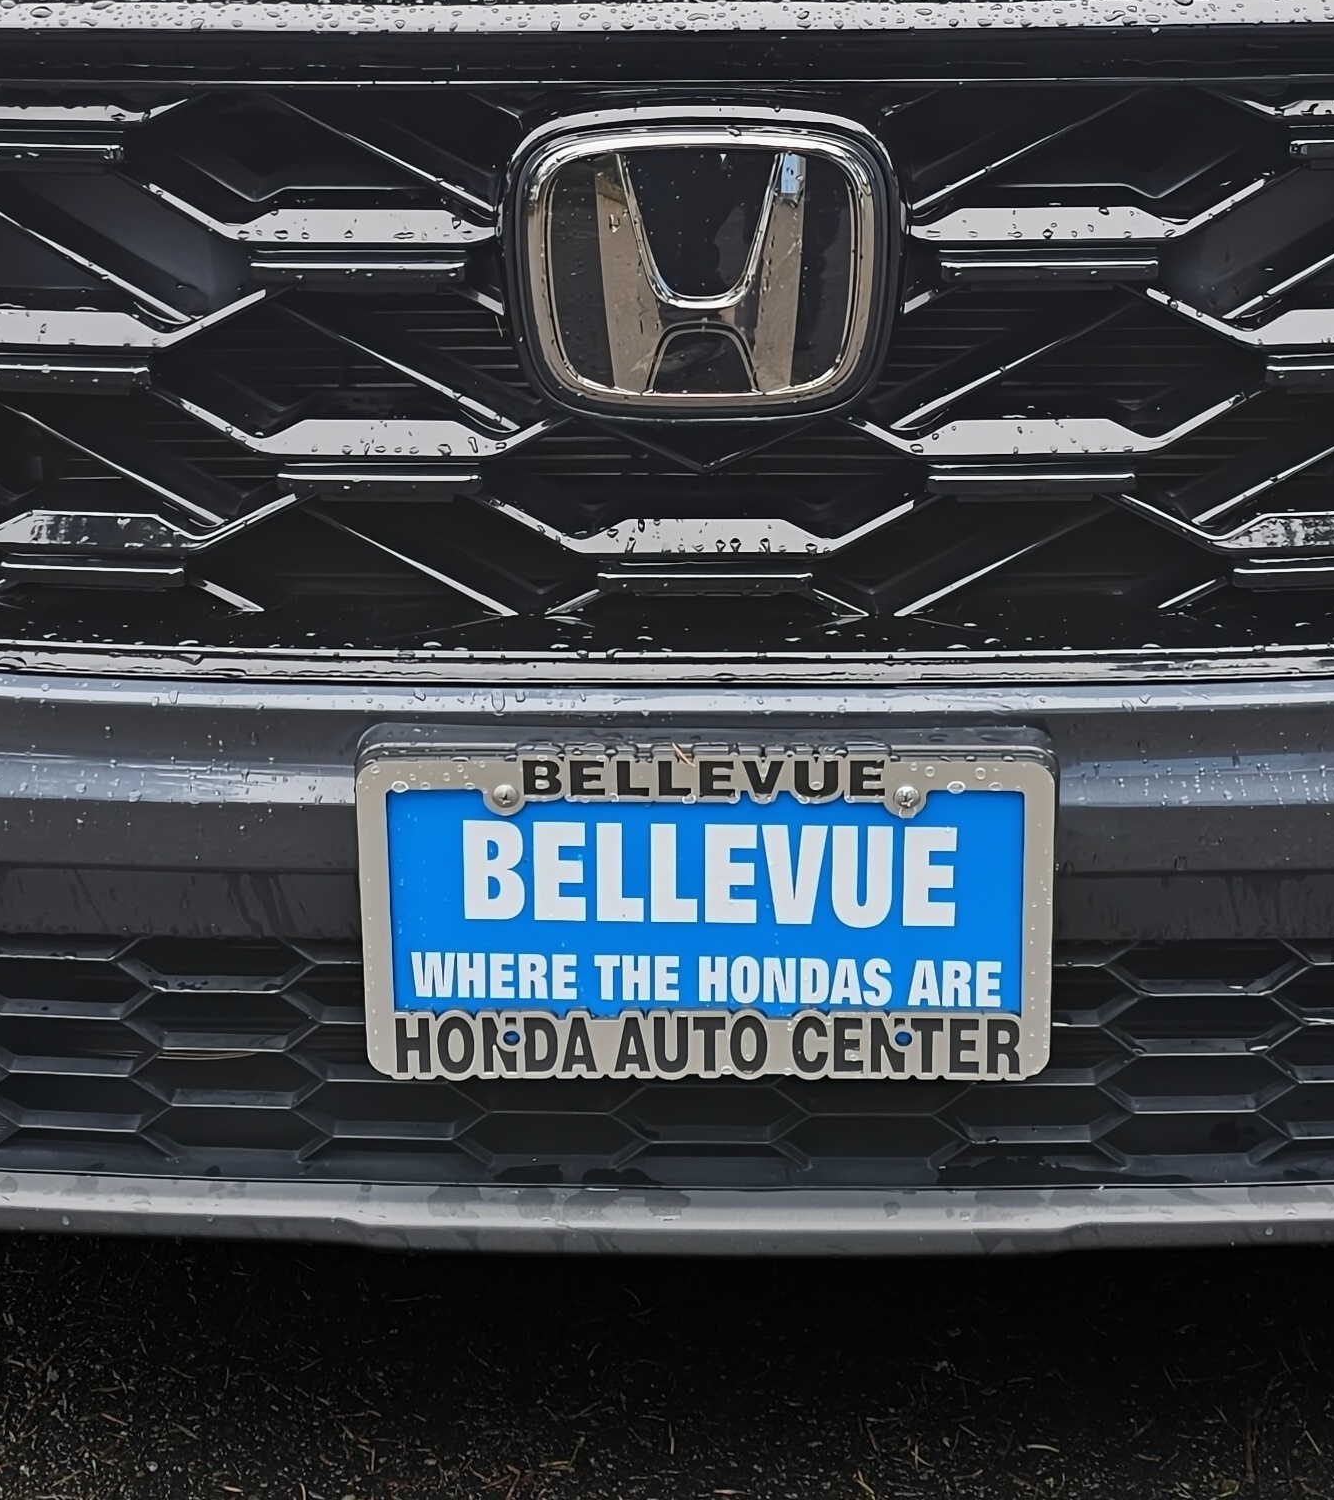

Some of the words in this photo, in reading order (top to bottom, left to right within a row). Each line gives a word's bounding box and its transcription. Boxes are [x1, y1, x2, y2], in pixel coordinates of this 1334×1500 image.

[521, 759, 885, 799] BELLEVUE
[461, 818, 958, 929] BELLEVUE
[411, 951, 577, 1000] WHERE
[594, 954, 681, 1003] THE
[697, 955, 892, 1007] HONDAS
[908, 959, 1003, 1008] ARE
[395, 1016, 590, 1074] HONDA
[615, 1016, 768, 1075] AUTO
[791, 1016, 1022, 1075] CENTER
